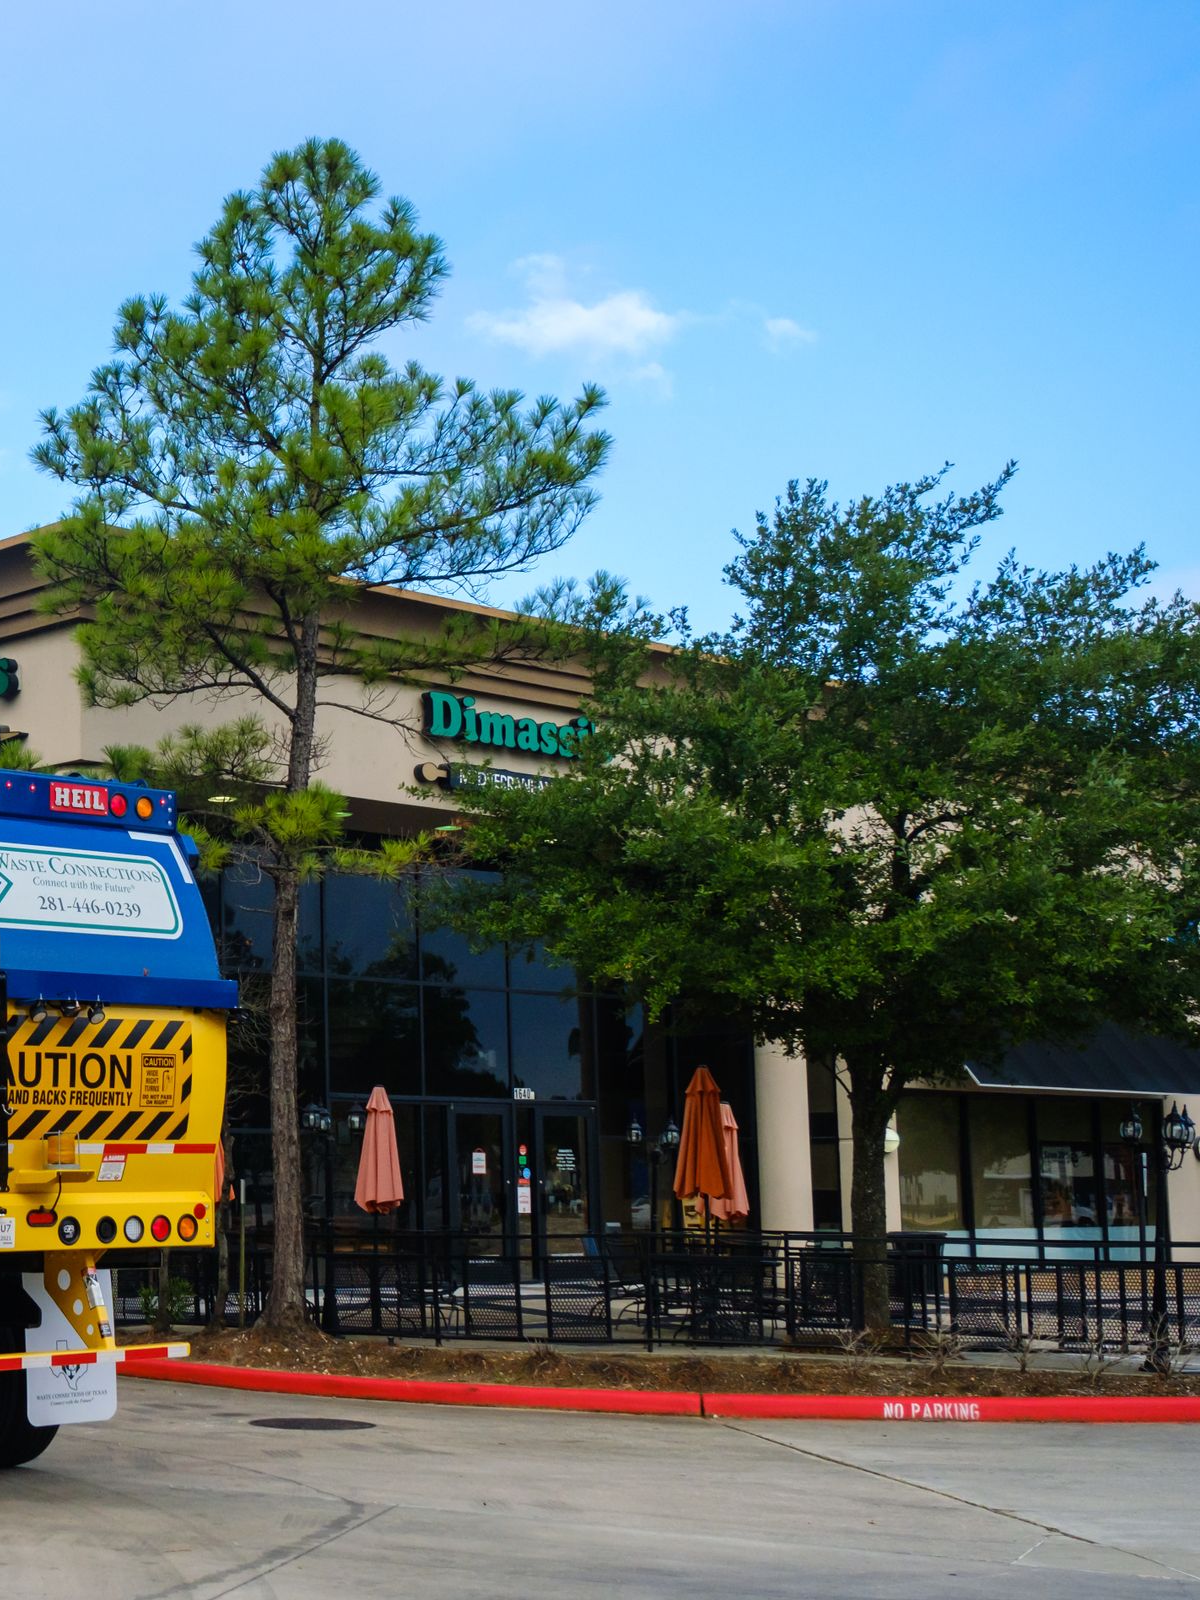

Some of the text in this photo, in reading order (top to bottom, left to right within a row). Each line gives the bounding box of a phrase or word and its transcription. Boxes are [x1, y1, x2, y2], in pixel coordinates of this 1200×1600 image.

[429, 690, 608, 762] Dimassi'
[54, 787, 105, 811] HEIL
[48, 857, 161, 883] CONNECTIONS
[32, 876, 68, 889] Connect
[70, 878, 88, 890] with
[90, 880, 103, 892] the
[38, 895, 141, 918] 281-446-0239
[144, 1057, 174, 1067] CAUTION
[9, 1090, 28, 1105] AND
[32, 1090, 66, 1105] BACKS
[69, 1091, 133, 1107] FREQUENTLY
[883, 1402, 980, 1420] NO PARKING
